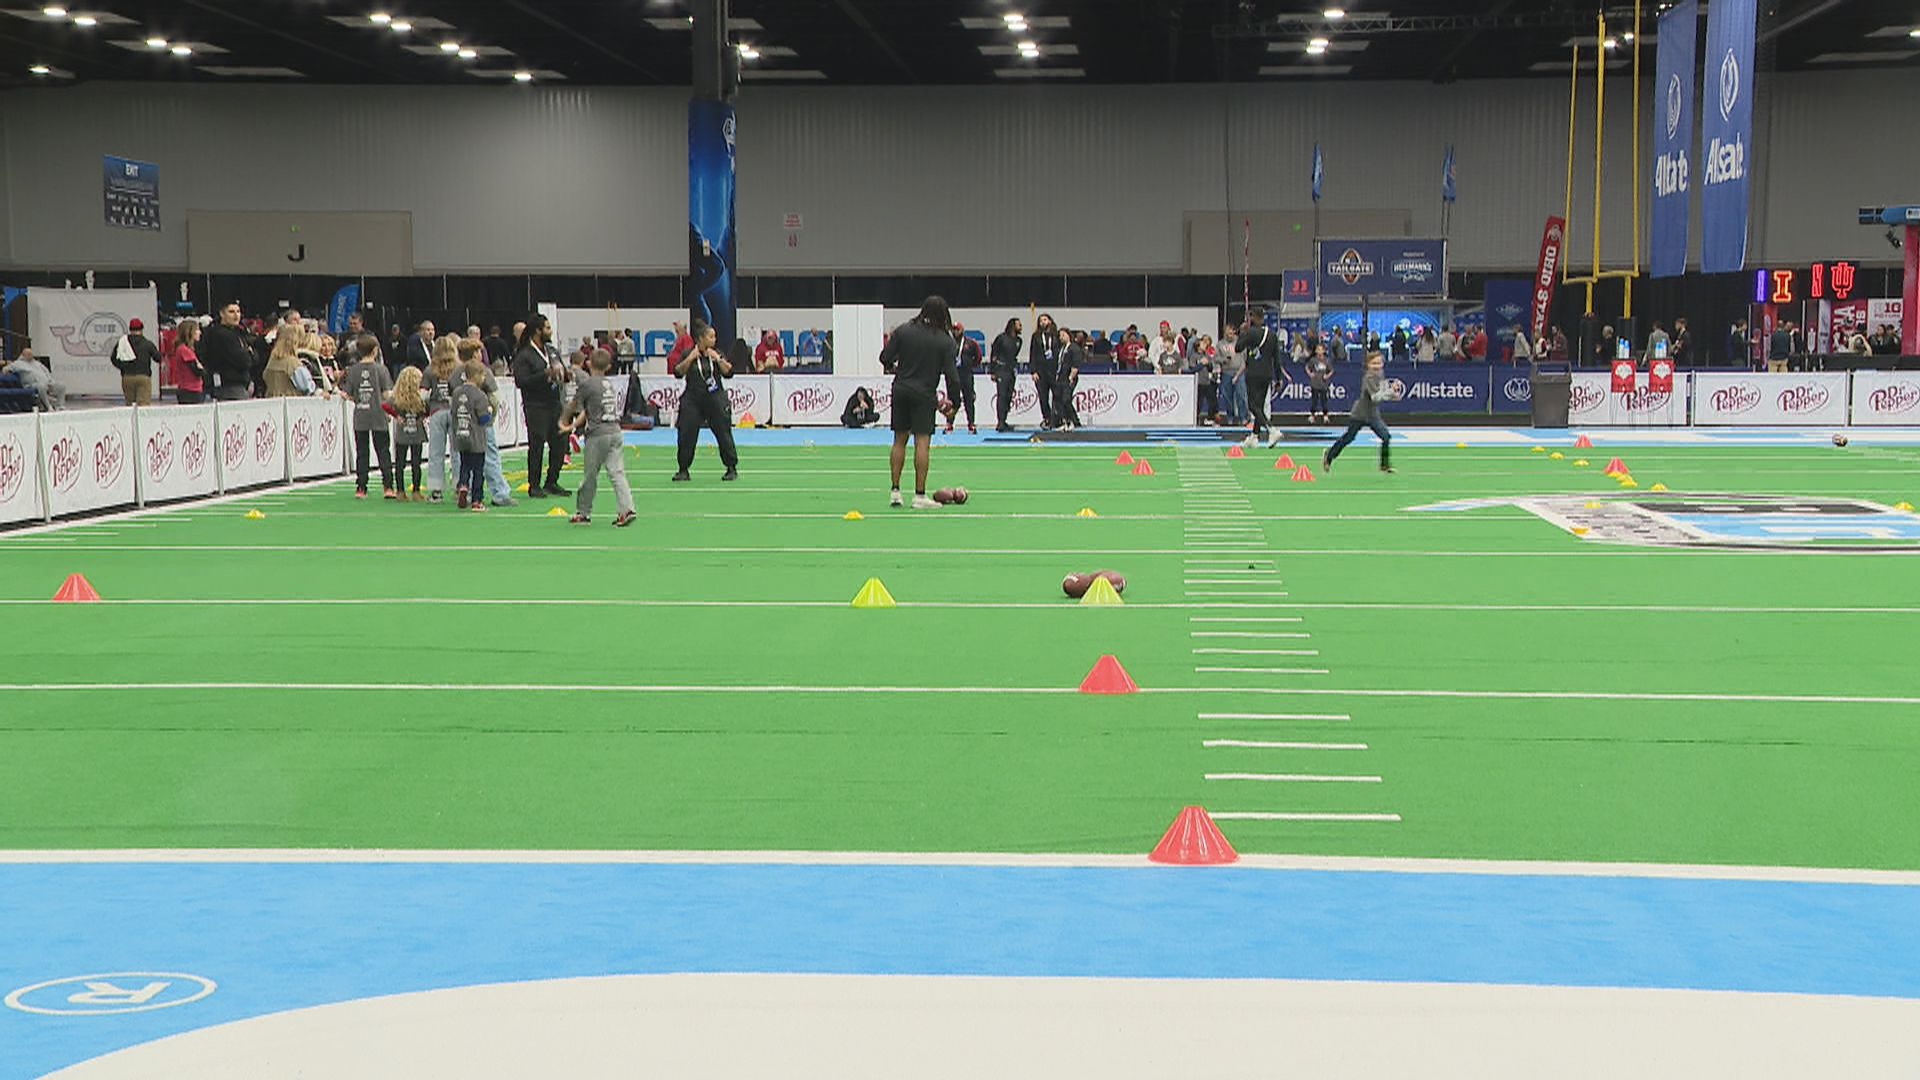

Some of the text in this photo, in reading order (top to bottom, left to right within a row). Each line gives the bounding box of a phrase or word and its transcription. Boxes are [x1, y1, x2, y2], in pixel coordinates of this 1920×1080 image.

[1704, 131, 1744, 185] Allsate
[125, 163, 139, 177] EXIT
[287, 243, 305, 262] J
[1533, 245, 1557, 338] OHIO STAT
[804, 388, 820, 400] Dr
[1087, 387, 1103, 400] Dr
[1150, 387, 1166, 400] Dr
[1280, 382, 1346, 399] Allste
[1407, 382, 1474, 399] Allstate
[1577, 385, 1590, 396] Dr
[1728, 386, 1746, 398] Dr
[1795, 386, 1813, 397] Dr
[1887, 385, 1905, 397] Dr
[648, 390, 680, 412] Pepp
[793, 391, 832, 412] Pepper
[1009, 393, 1035, 410] pper
[1073, 391, 1114, 413] Pepper
[1135, 391, 1177, 413] Pepper
[1569, 390, 1600, 411] epper
[1713, 389, 1758, 411] Pepper
[1780, 389, 1825, 411] Pepper
[1871, 389, 1919, 411] Pepper
